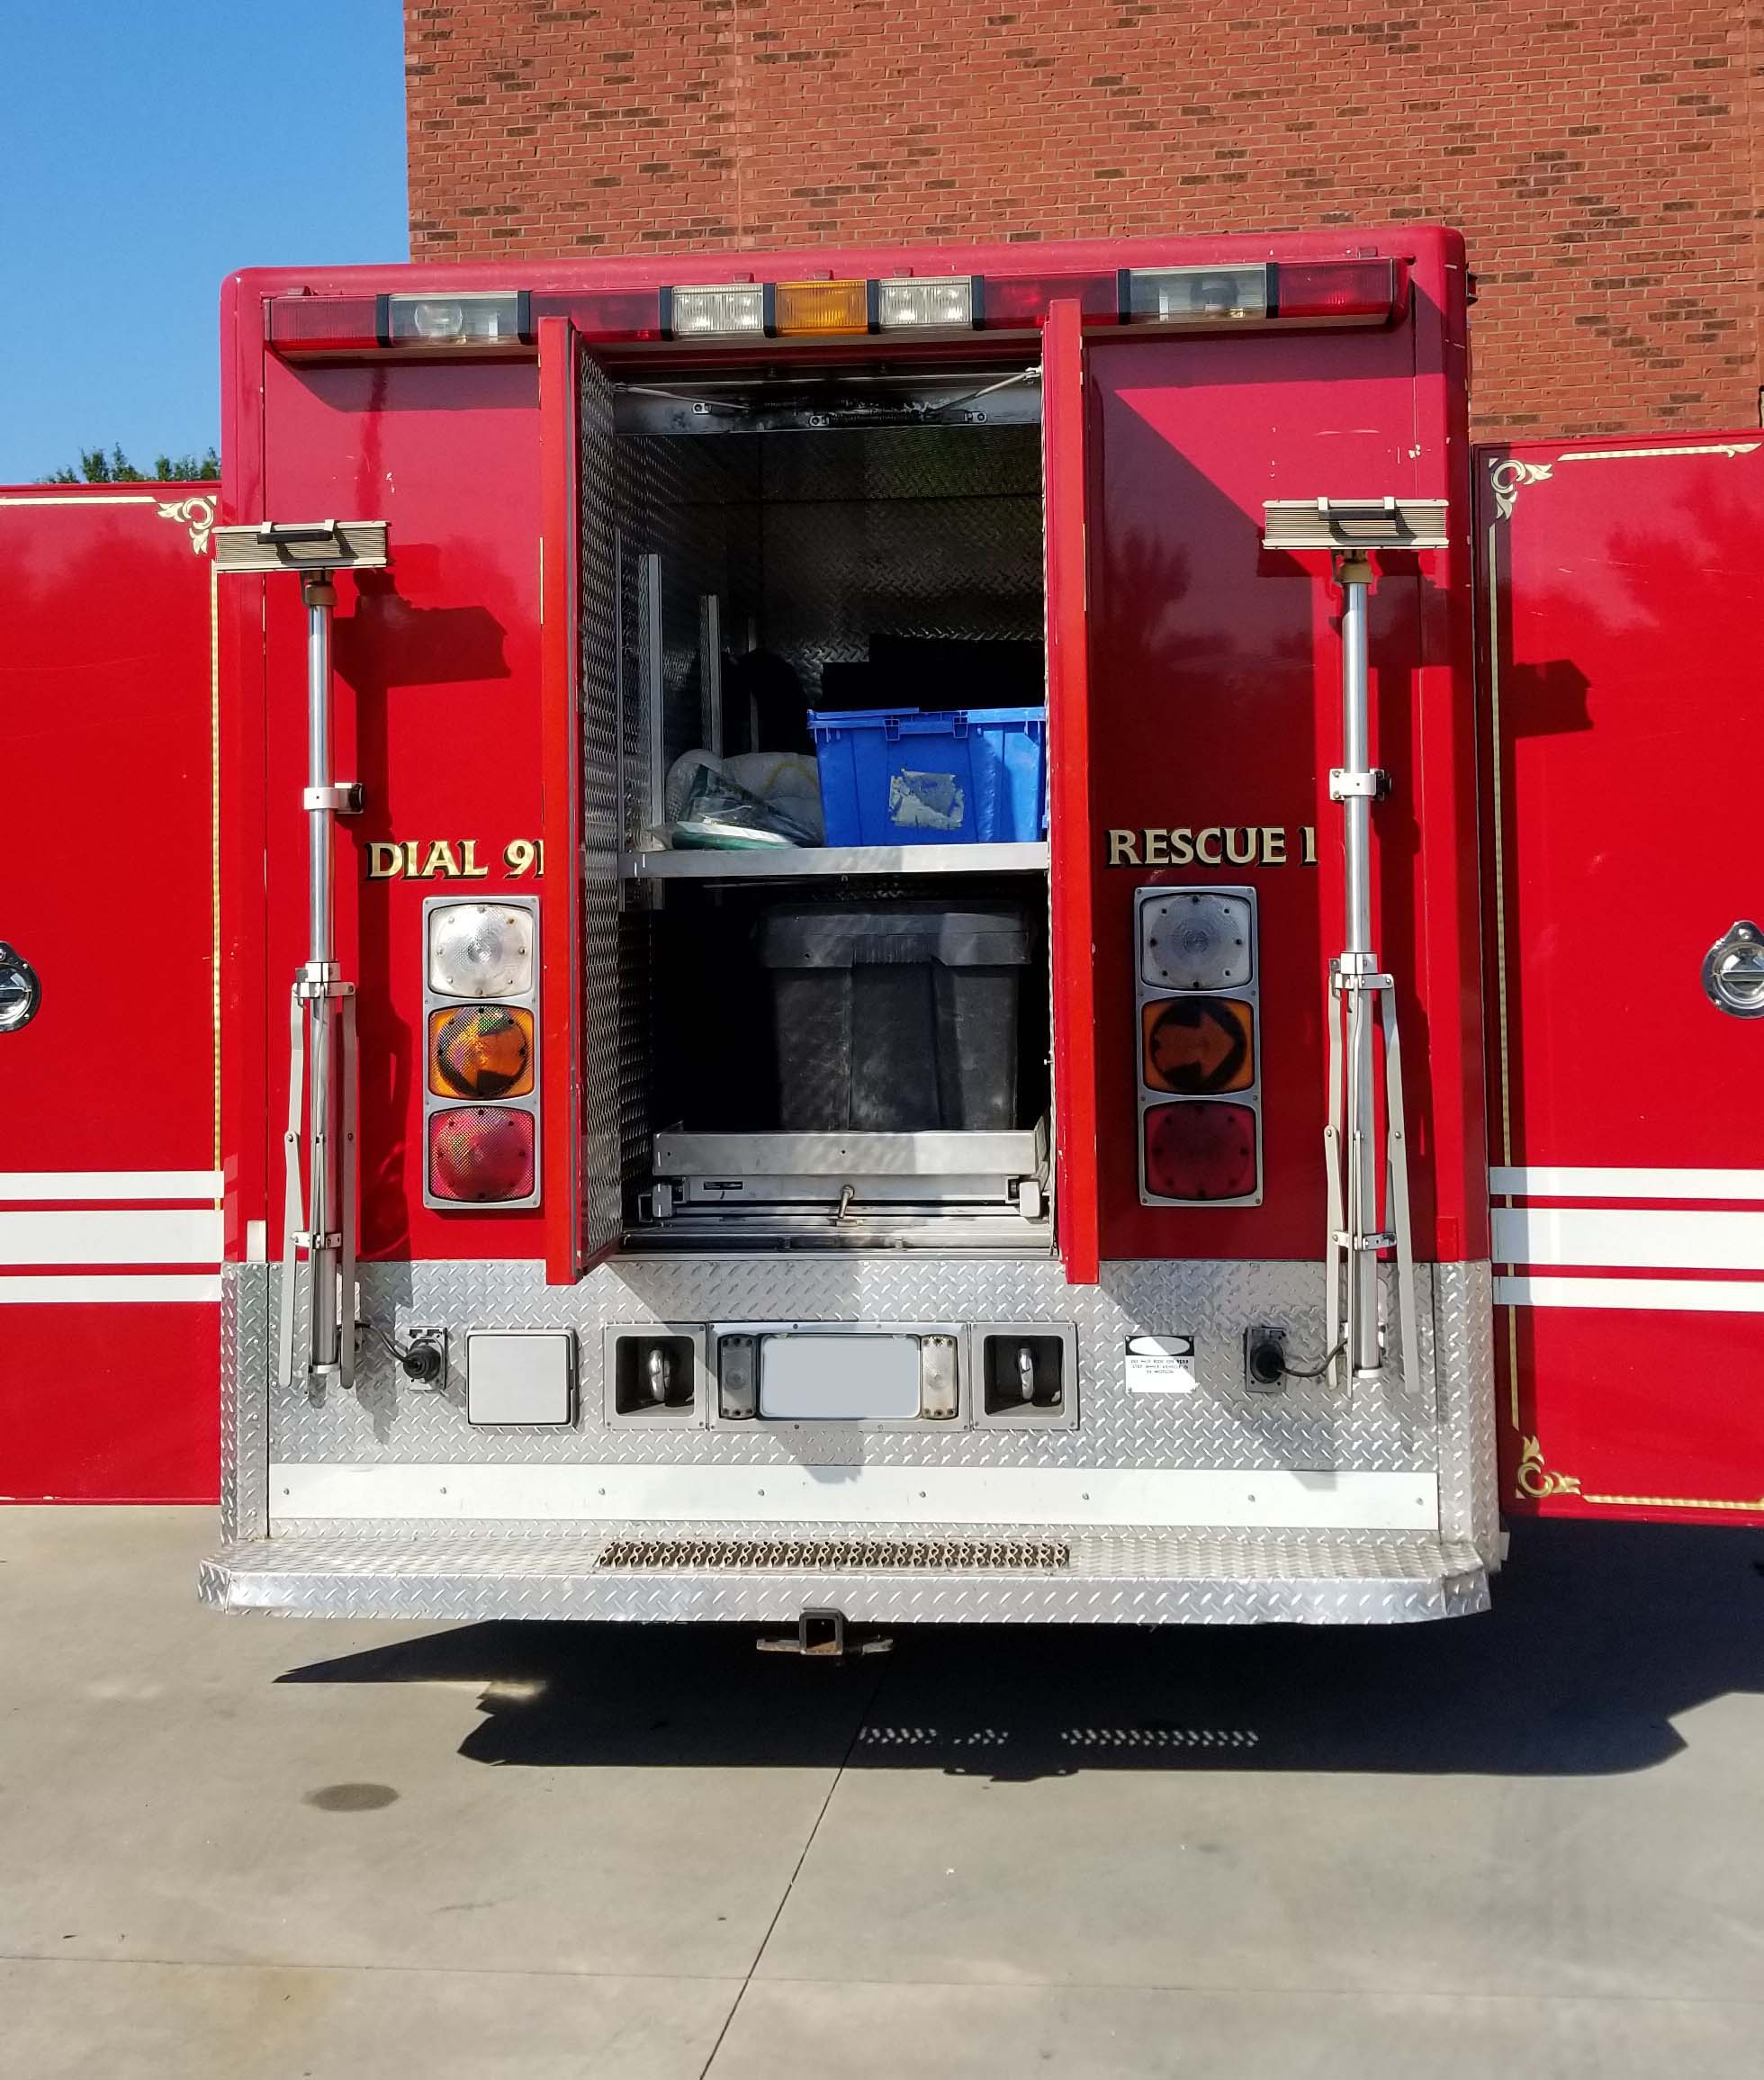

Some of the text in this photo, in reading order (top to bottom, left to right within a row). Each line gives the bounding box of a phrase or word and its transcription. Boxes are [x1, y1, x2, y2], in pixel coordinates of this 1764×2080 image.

[365, 840, 489, 880] DIAL
[1106, 825, 1319, 867] RESCUE 1
